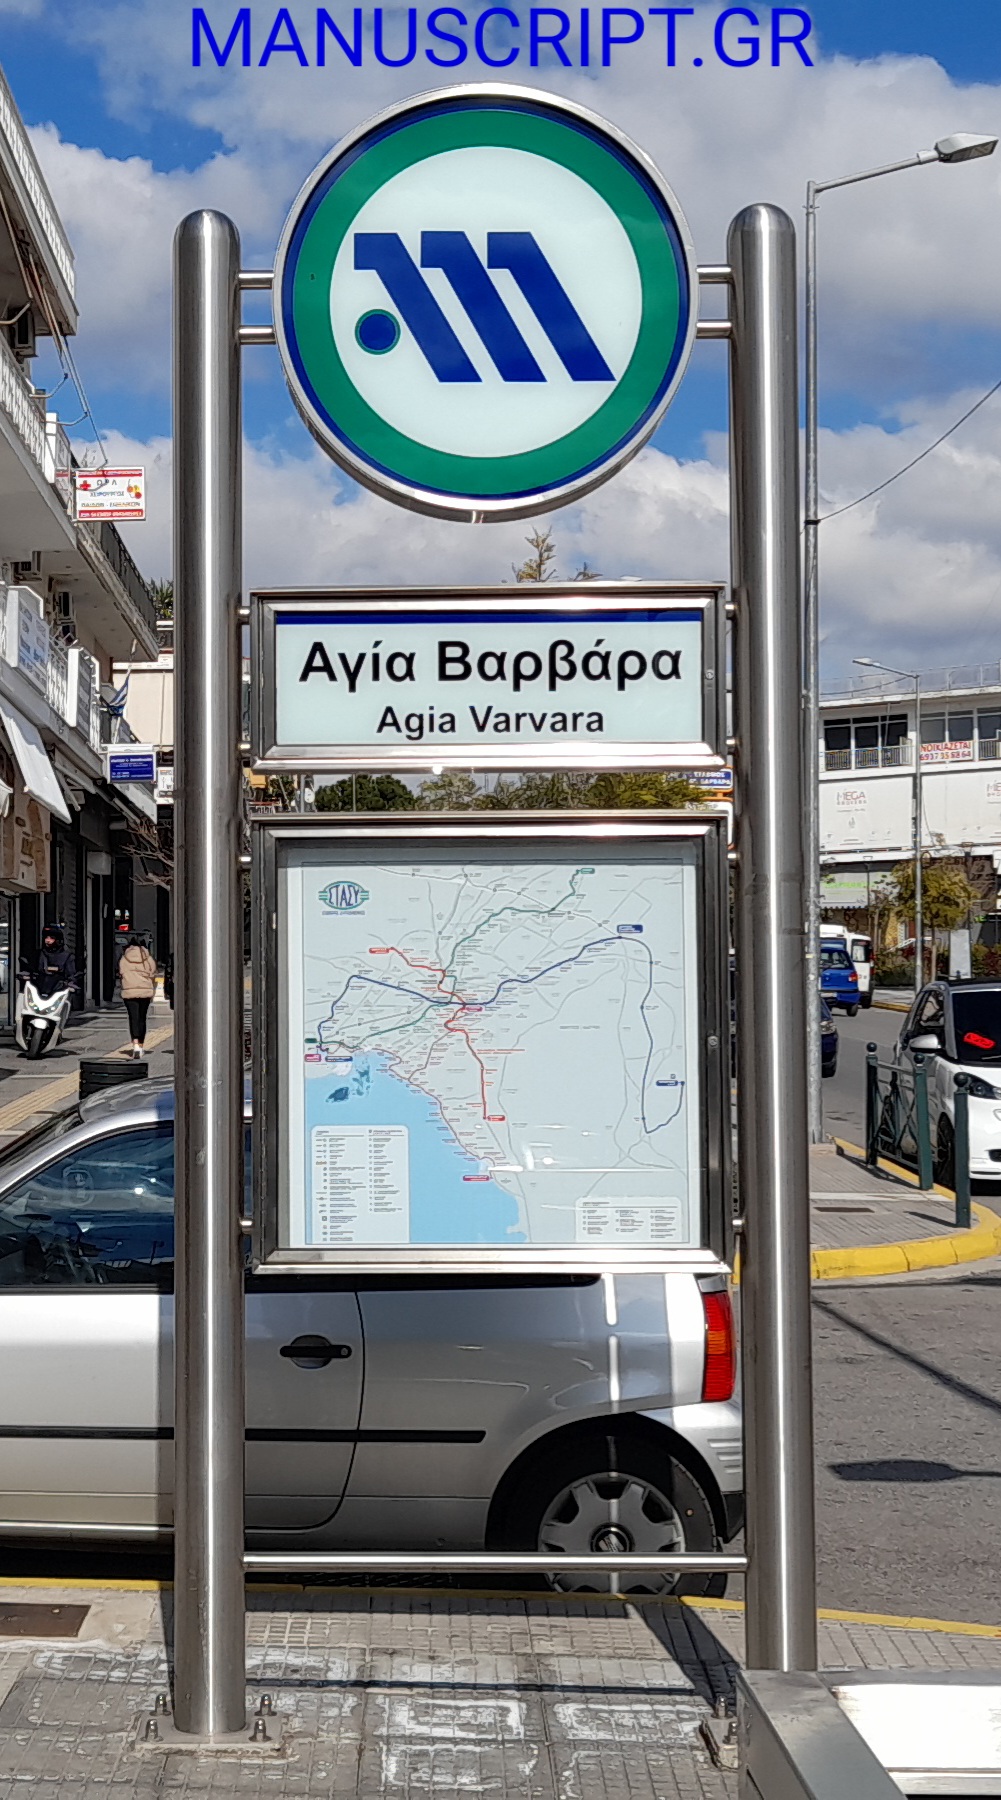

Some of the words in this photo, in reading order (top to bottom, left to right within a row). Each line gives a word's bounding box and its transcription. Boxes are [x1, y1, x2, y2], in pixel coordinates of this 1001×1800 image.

[299, 640, 416, 694] Αγία
[438, 638, 683, 693] Βαρβάρα
[376, 705, 457, 741] Agia
[469, 704, 605, 734] Varvara
[919, 741, 972, 753] ΝΟΙΚΙΑΖΕΤΑΙ
[837, 790, 866, 801] MEGA
[328, 884, 360, 907] ΣΤΑΣΥ
